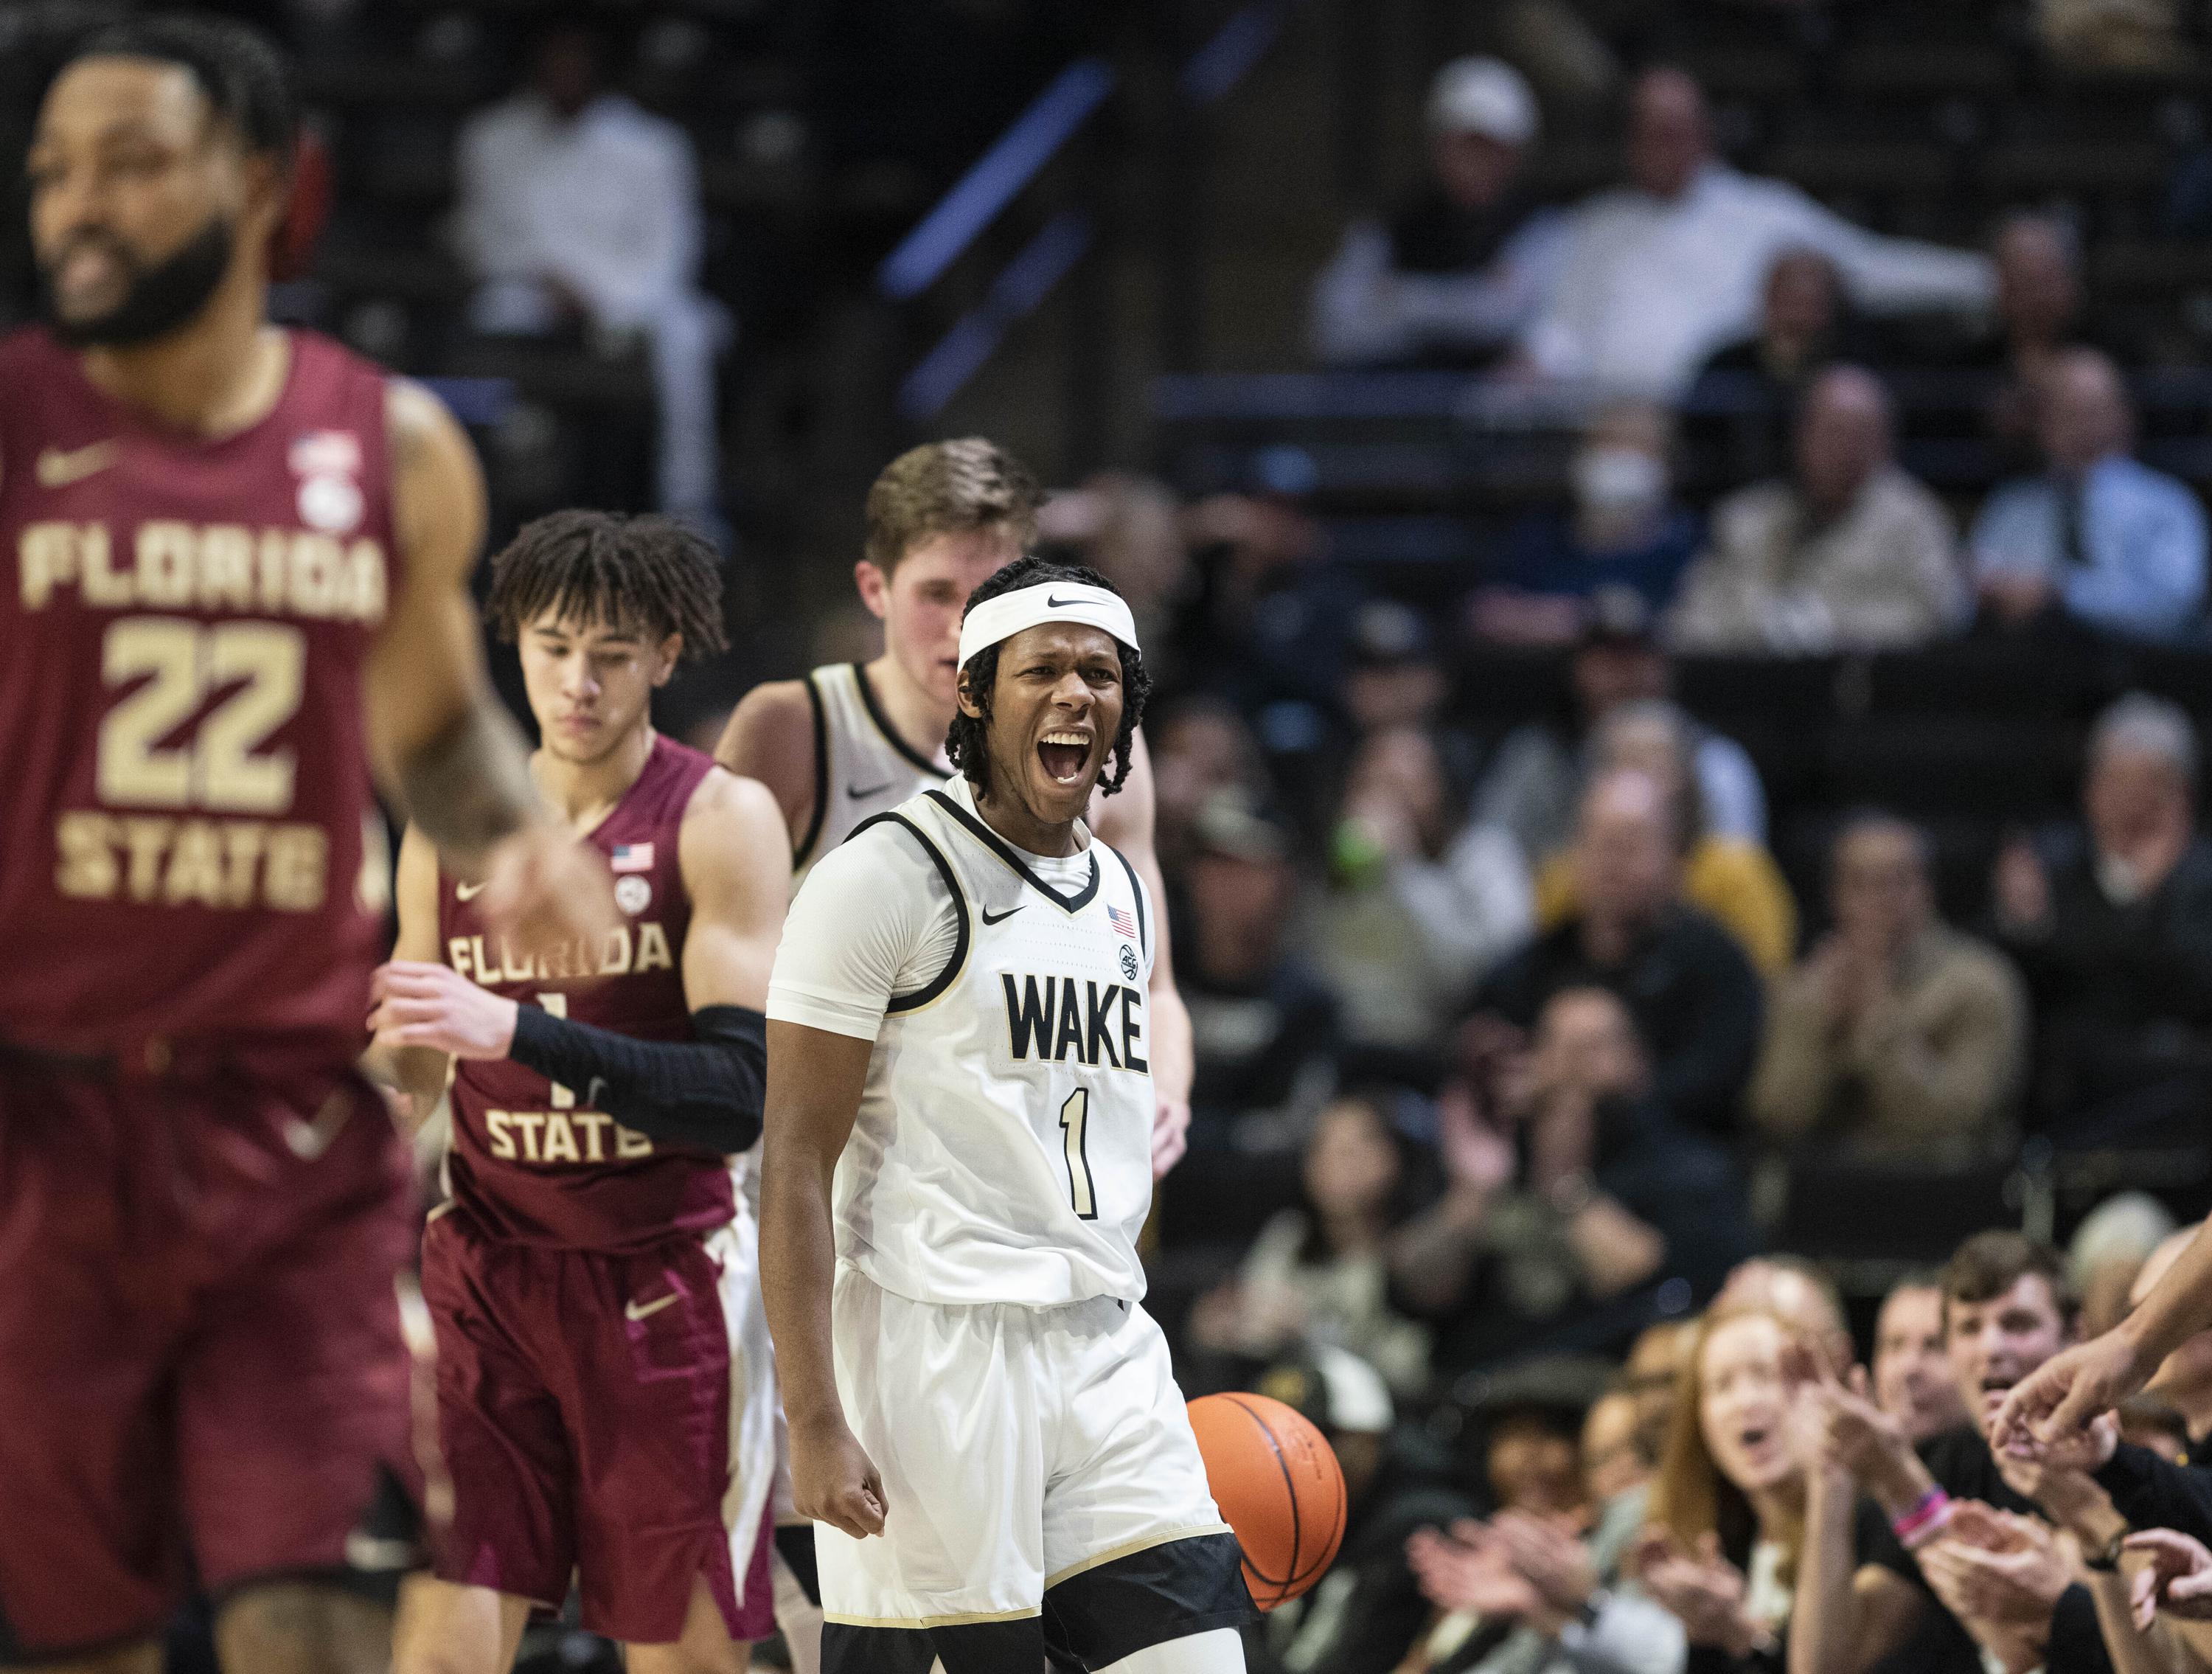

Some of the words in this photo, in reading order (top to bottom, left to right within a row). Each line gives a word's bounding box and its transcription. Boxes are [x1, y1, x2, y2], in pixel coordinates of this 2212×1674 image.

[99, 618, 305, 811] 22
[58, 811, 329, 912] STATE
[1122, 954, 1137, 969] ACC
[1000, 972, 1150, 1076] WAKE
[1059, 1087, 1099, 1220] 1
